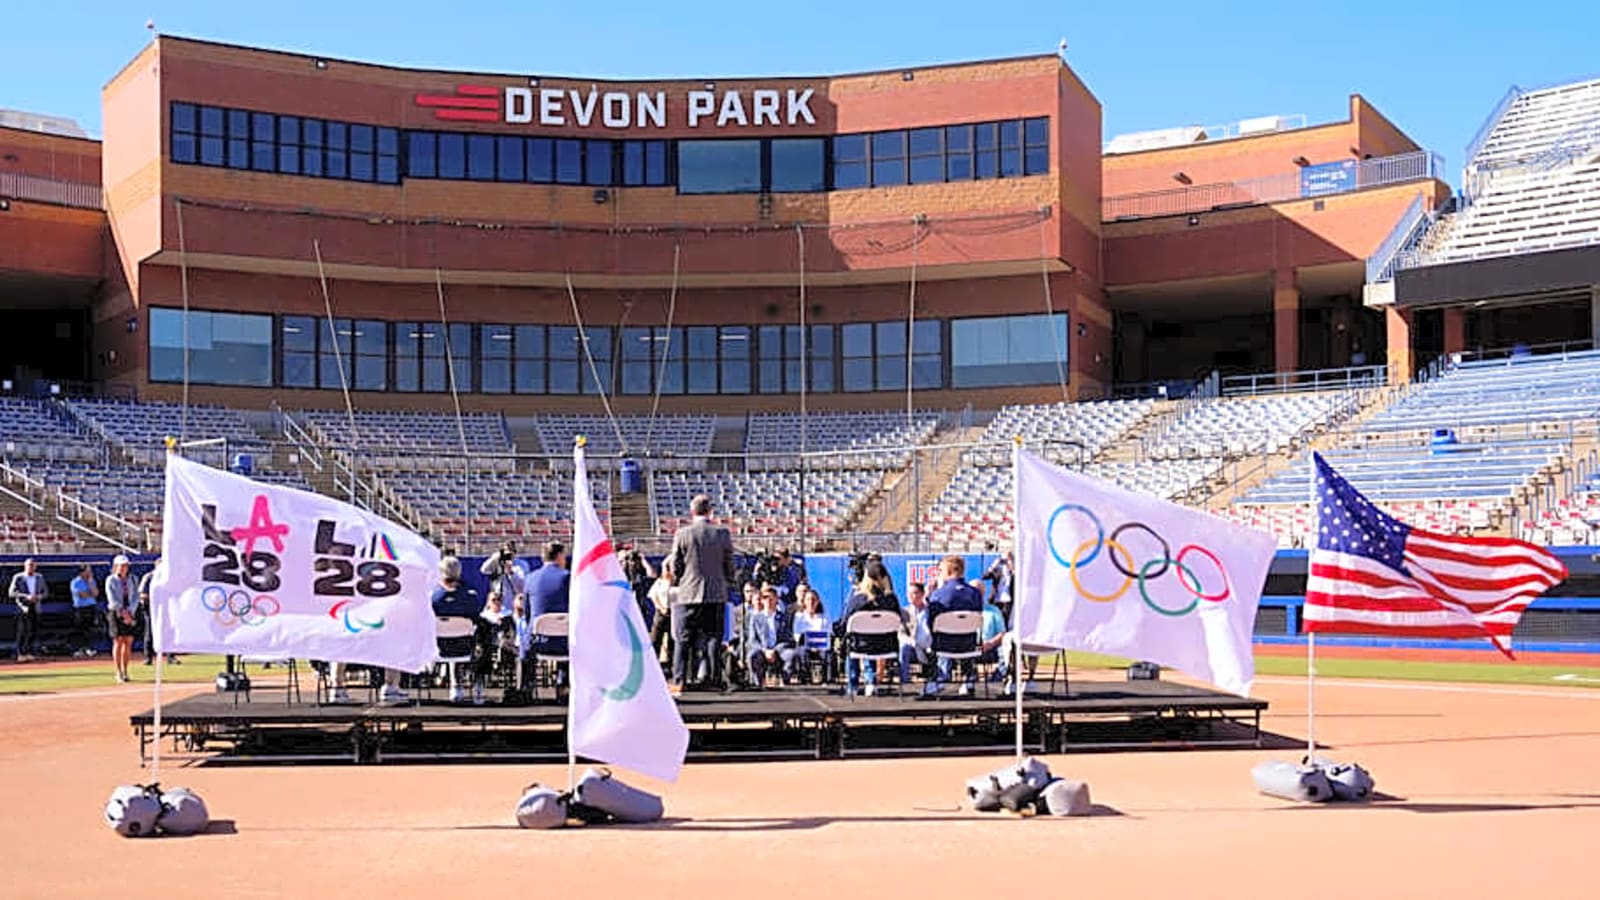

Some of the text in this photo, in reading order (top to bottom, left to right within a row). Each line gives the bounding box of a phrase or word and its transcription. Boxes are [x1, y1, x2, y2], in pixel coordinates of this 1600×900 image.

[505, 87, 816, 128] DEVON PARK
[201, 495, 290, 560] LA
[202, 543, 281, 593] 28
[313, 557, 401, 597] 28
